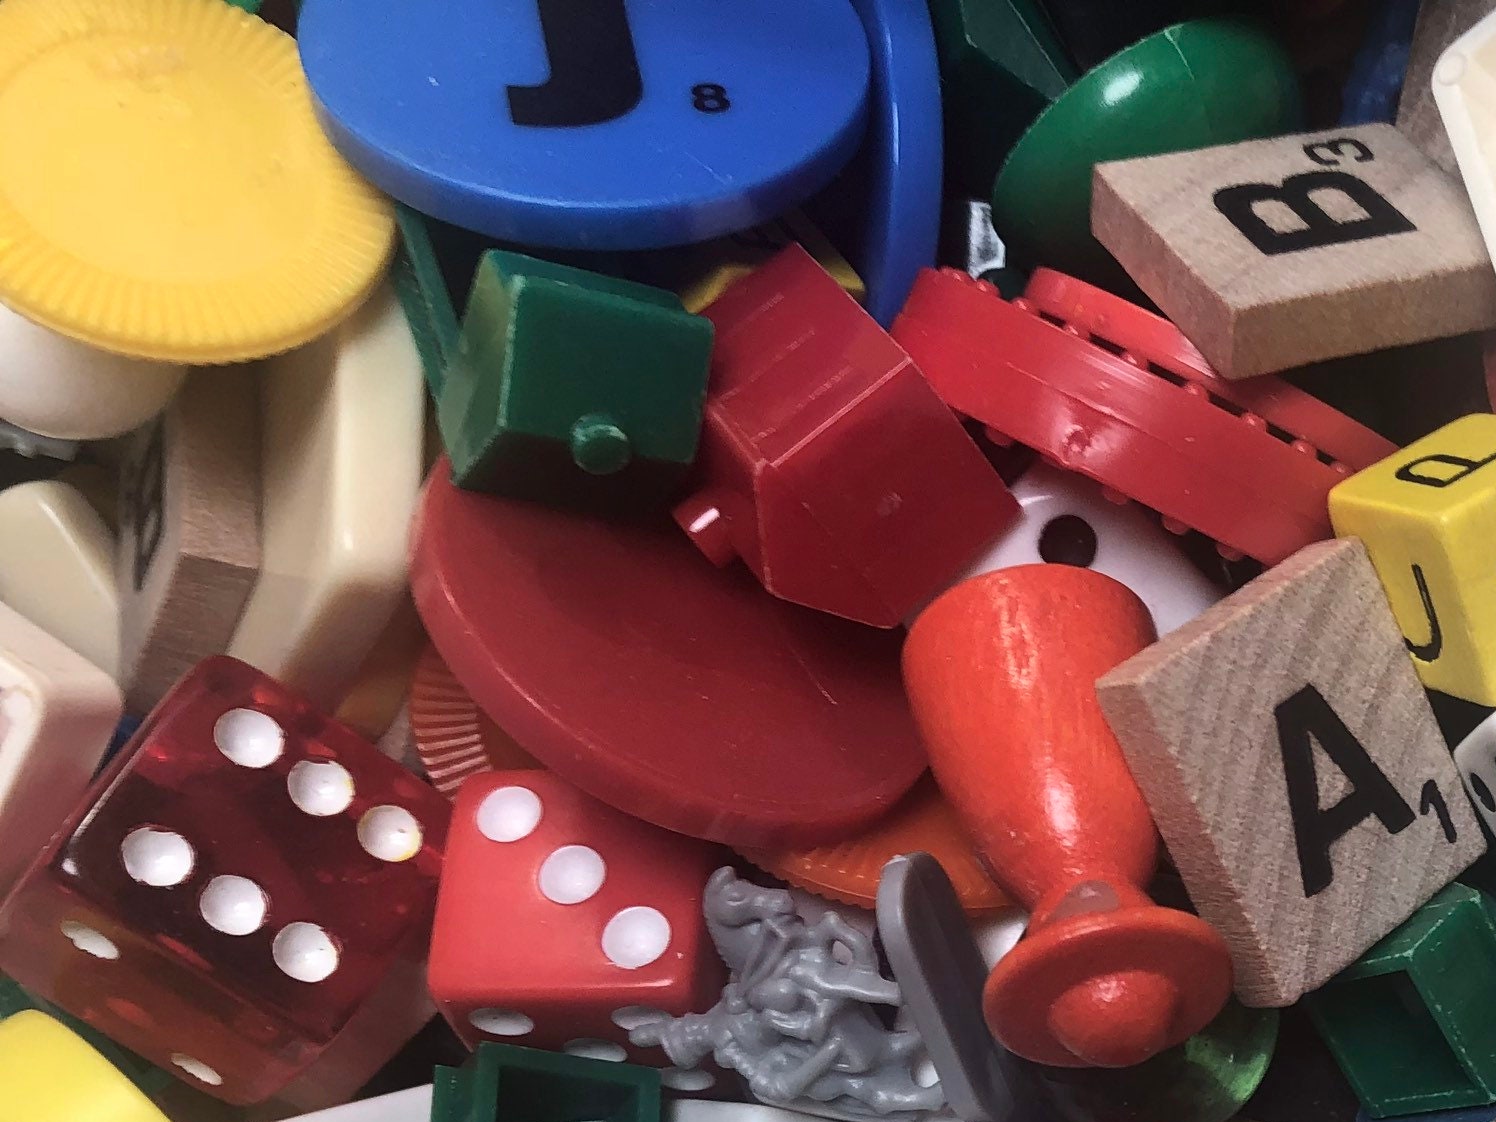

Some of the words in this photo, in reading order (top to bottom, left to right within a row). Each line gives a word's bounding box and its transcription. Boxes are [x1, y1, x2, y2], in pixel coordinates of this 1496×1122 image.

[506, 0, 643, 126] J
[691, 83, 731, 114] 8
[1303, 137, 1374, 165] 3
[1212, 170, 1417, 256] B
[1273, 683, 1416, 898] A
[1420, 779, 1458, 844] 1
